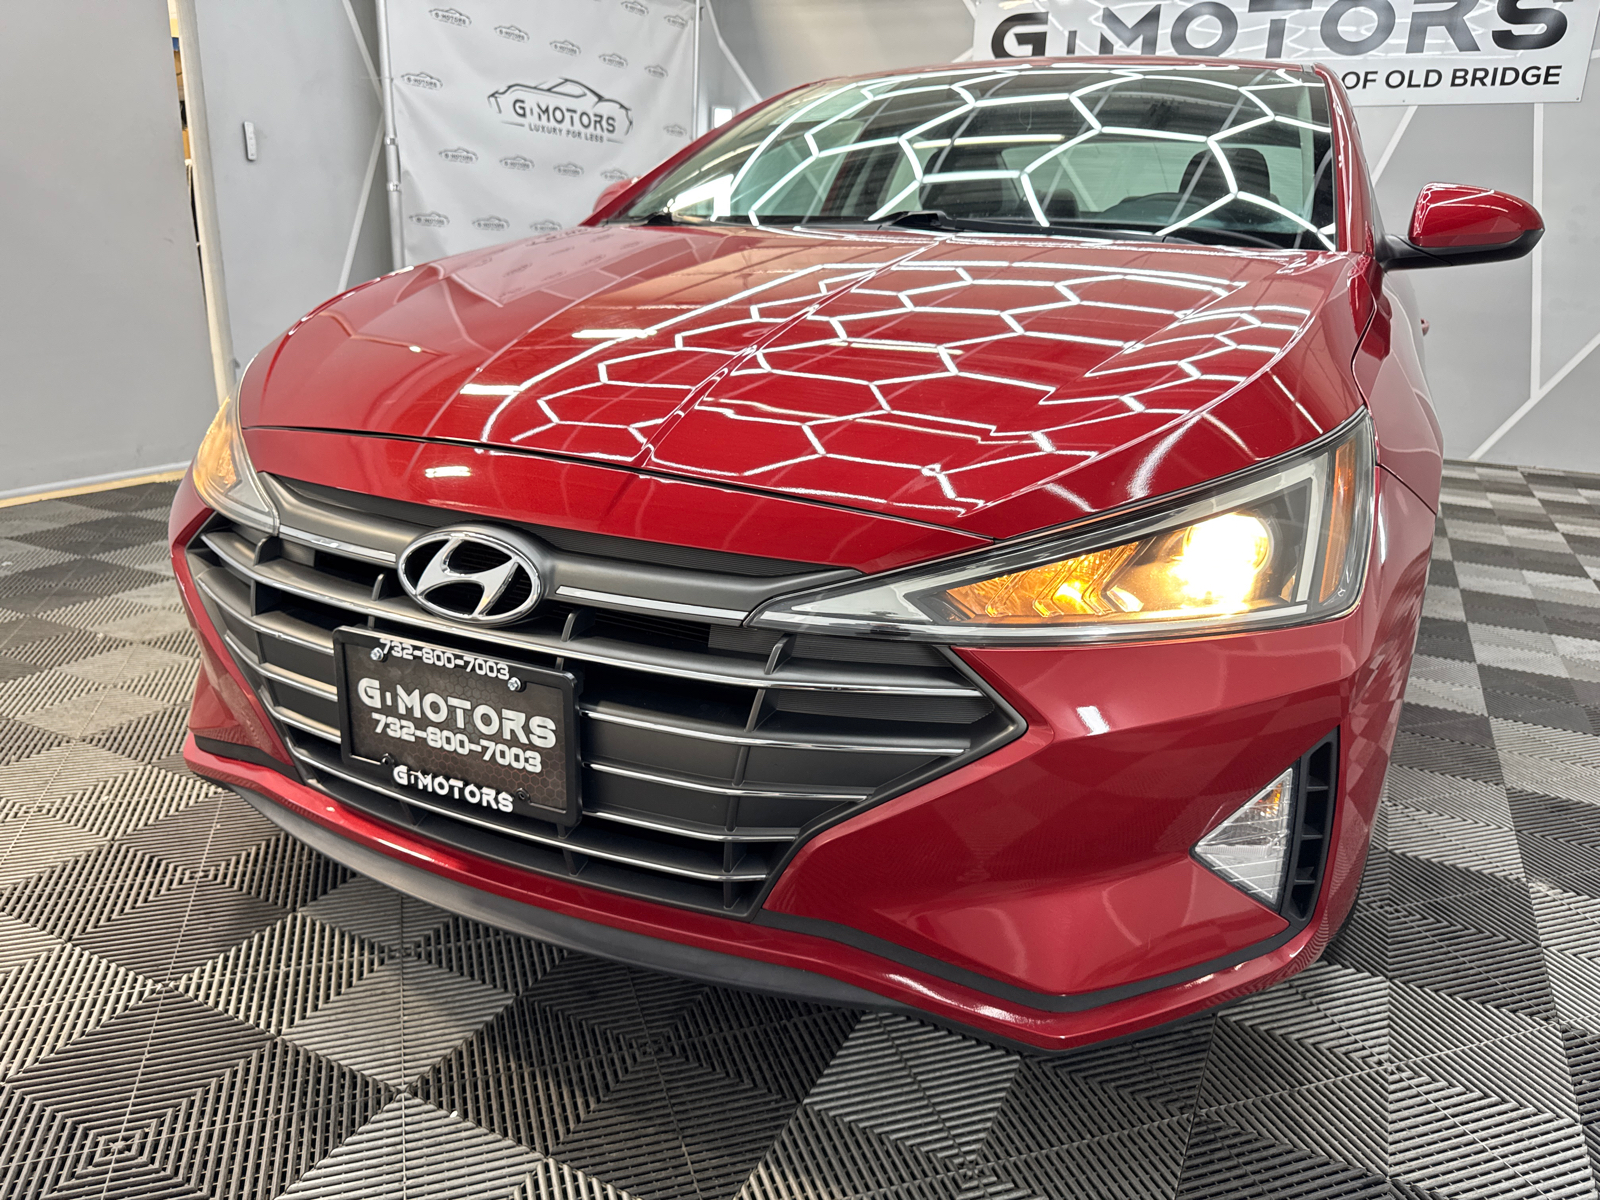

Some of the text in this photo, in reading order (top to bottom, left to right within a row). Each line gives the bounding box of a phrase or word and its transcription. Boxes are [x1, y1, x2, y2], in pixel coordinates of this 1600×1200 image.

[1343, 65, 1562, 91] OF OLD BRIDGE
[528, 123, 604, 143] LUXURY FOR LESS
[379, 638, 510, 680] 732-800-7003
[371, 712, 543, 774] 732-800-7003
